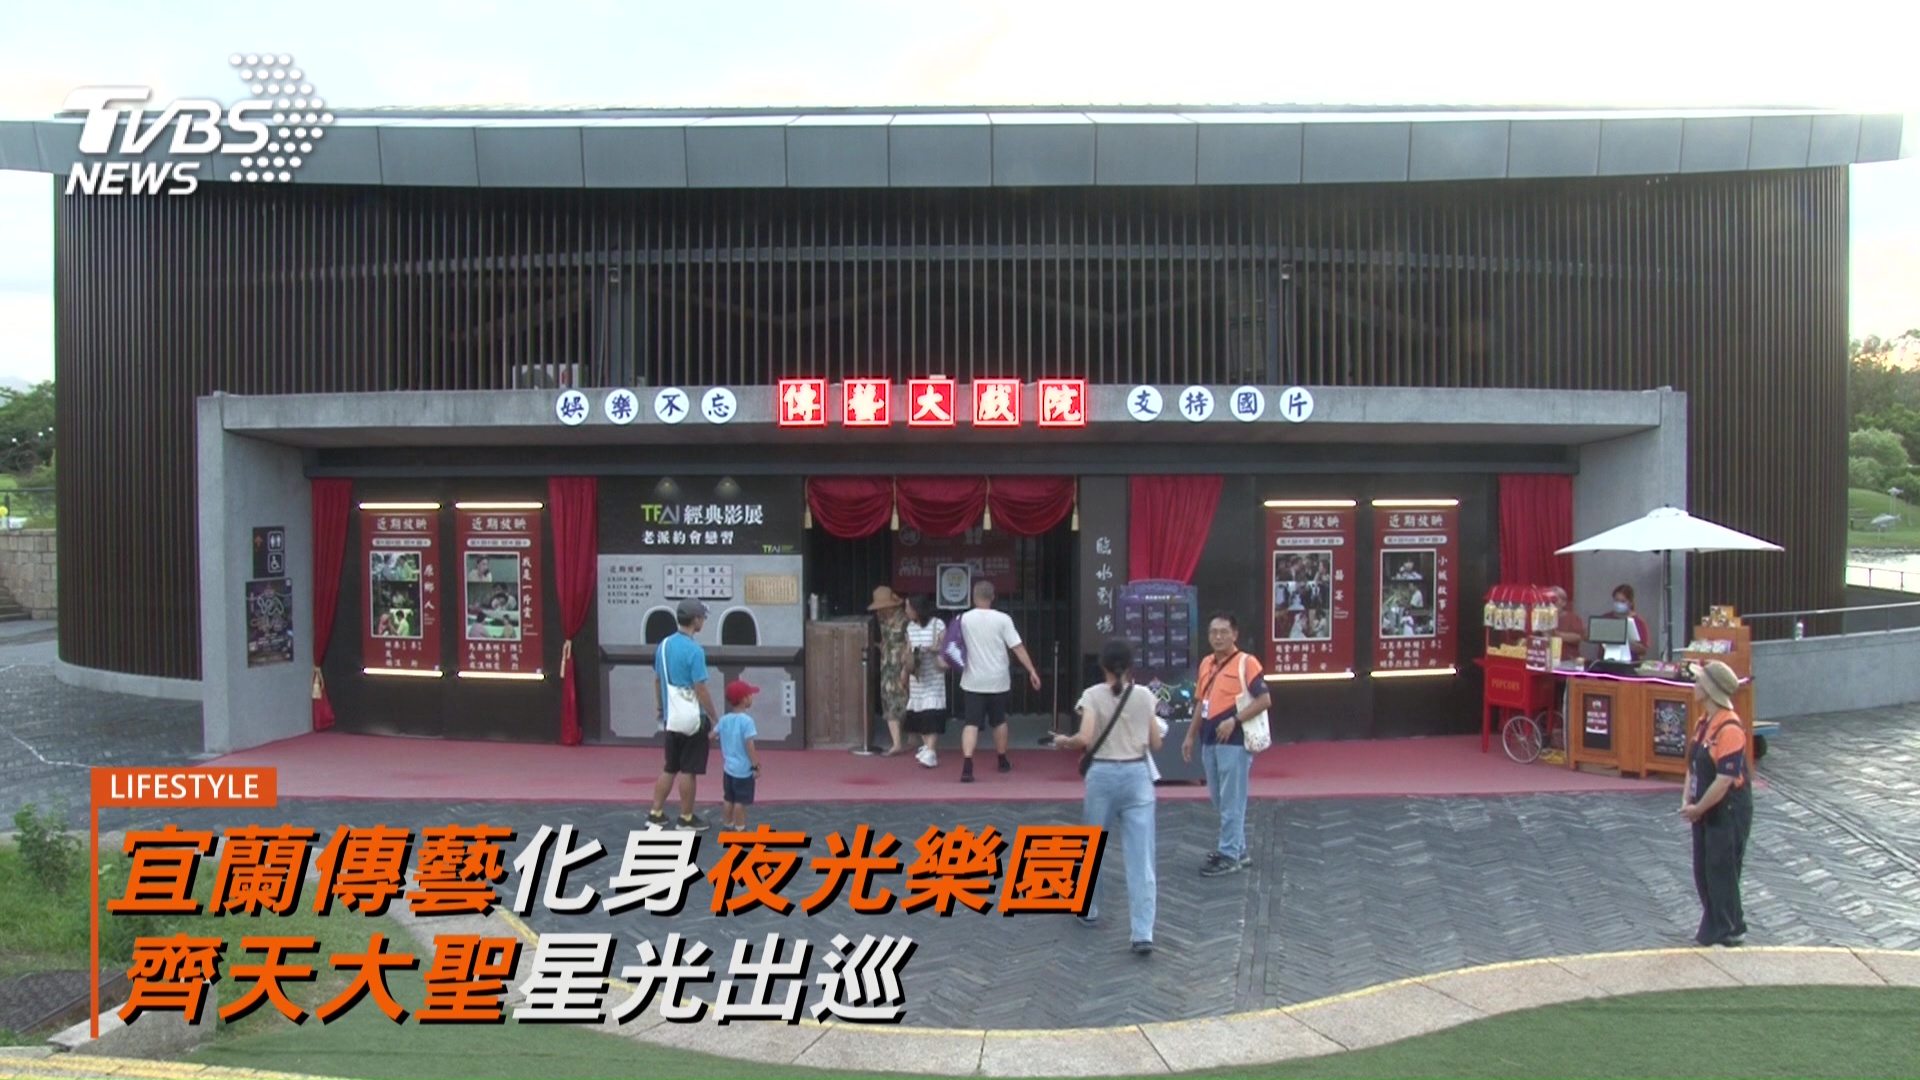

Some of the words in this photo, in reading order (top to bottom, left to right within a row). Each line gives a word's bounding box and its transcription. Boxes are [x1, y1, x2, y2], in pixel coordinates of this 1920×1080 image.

[561, 394, 729, 418] 娛樂不忘
[782, 384, 1080, 423] 傳藝大戲院
[1134, 390, 1307, 417] 支持國片
[684, 504, 763, 525] 經典影展
